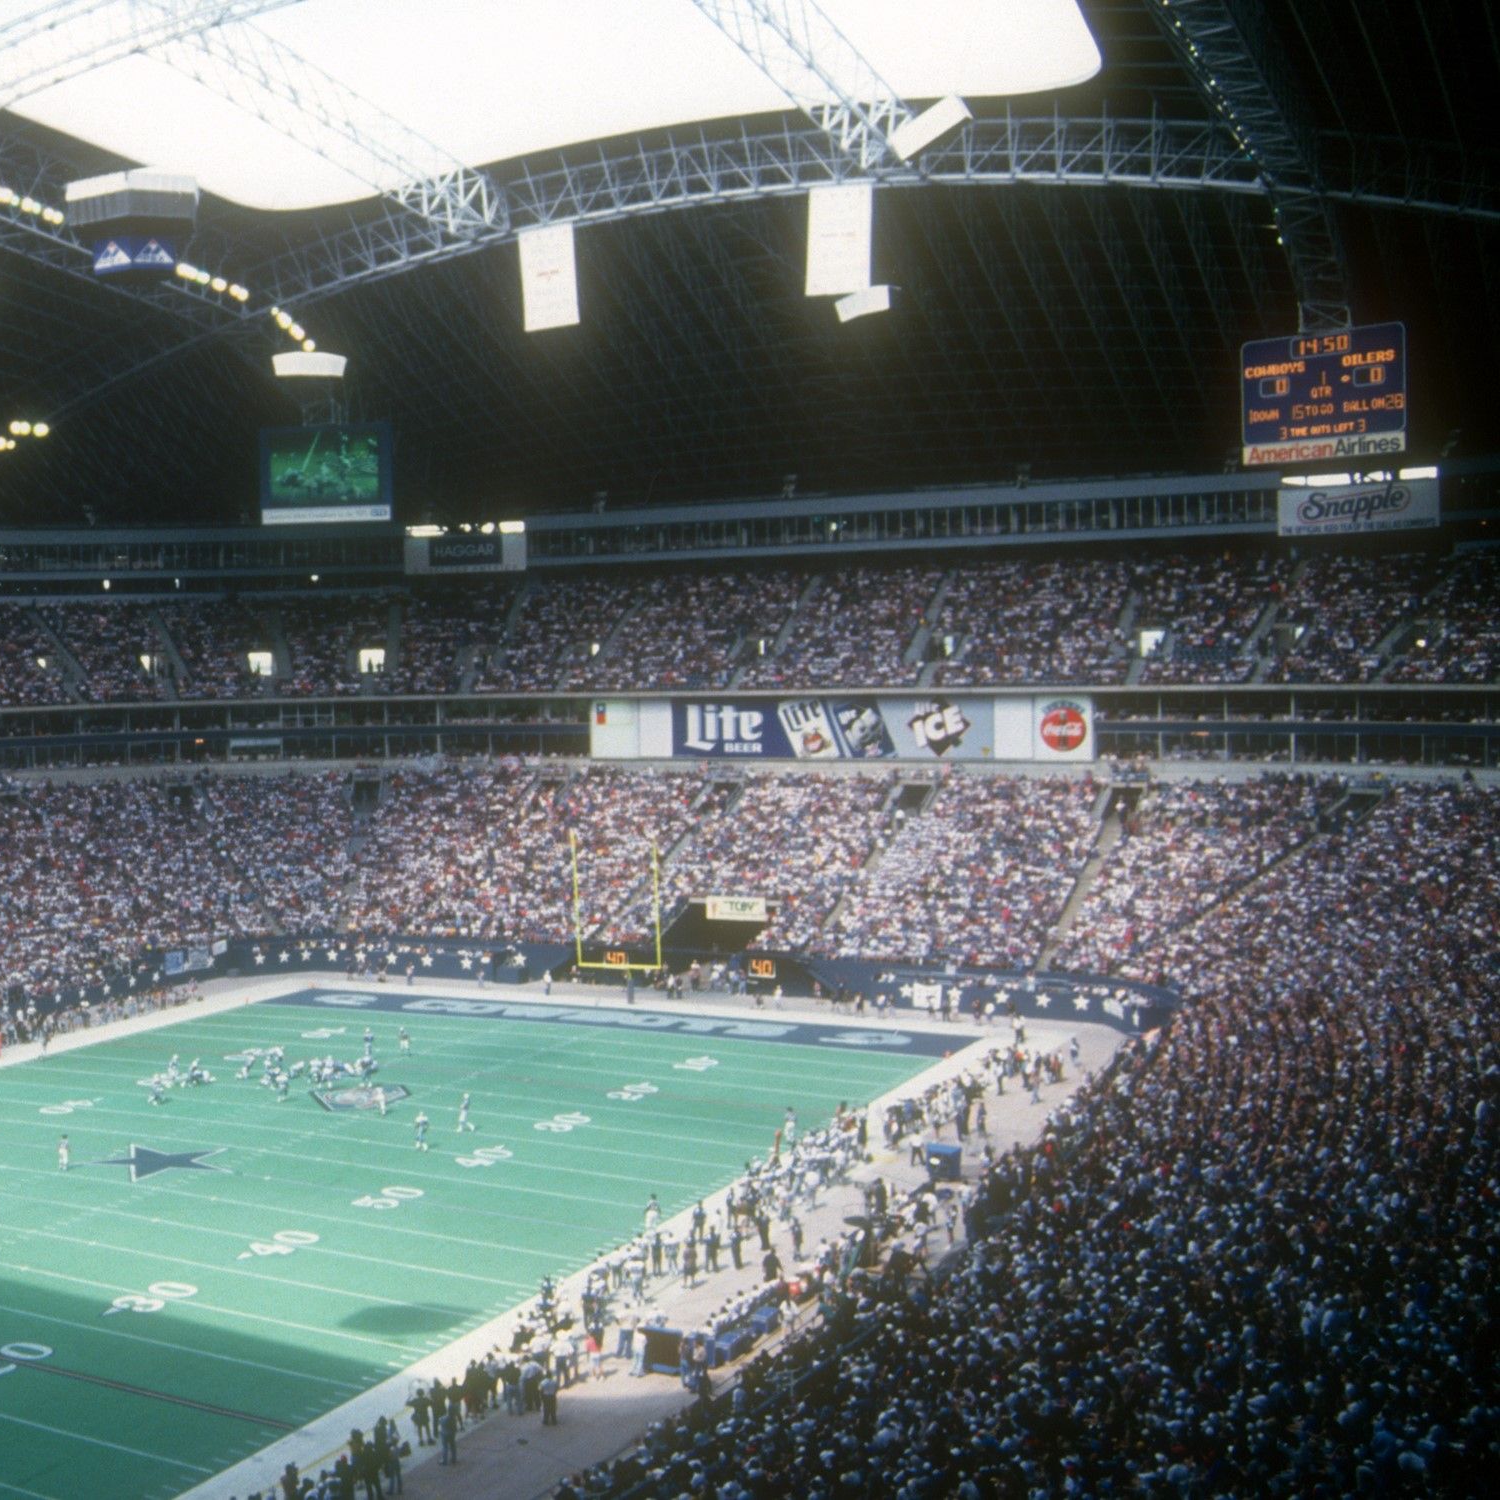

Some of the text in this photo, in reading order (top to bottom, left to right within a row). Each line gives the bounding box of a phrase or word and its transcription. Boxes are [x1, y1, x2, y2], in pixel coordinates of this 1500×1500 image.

[1342, 349, 1396, 367] OILERS
[1245, 361, 1306, 379] COWBOYS
[1322, 370, 1327, 385] 1
[1370, 367, 1381, 383] 0
[1276, 379, 1287, 394] 0
[1311, 386, 1332, 399] QTR
[1253, 408, 1280, 422] DOWN
[1305, 405, 1318, 416] TO
[1320, 404, 1334, 415] GO
[1343, 400, 1369, 413] BALL
[1372, 398, 1385, 409] ON
[1291, 426, 1308, 437] TIME
[1310, 424, 1331, 434] OUTS
[1333, 422, 1355, 433] LEFT
[1302, 482, 1404, 522] Snapple
[434, 544, 495, 558] HAGGAR
[781, 700, 821, 732] Lite
[684, 704, 764, 752] Lite
[912, 704, 965, 748] ICE
[723, 742, 762, 753] BEER
[752, 959, 773, 975] 40
[400, 1000, 799, 1037] COWBOYS
[357, 1186, 424, 1210] 50
[249, 1230, 320, 1255] 40
[112, 1281, 198, 1312] 30
